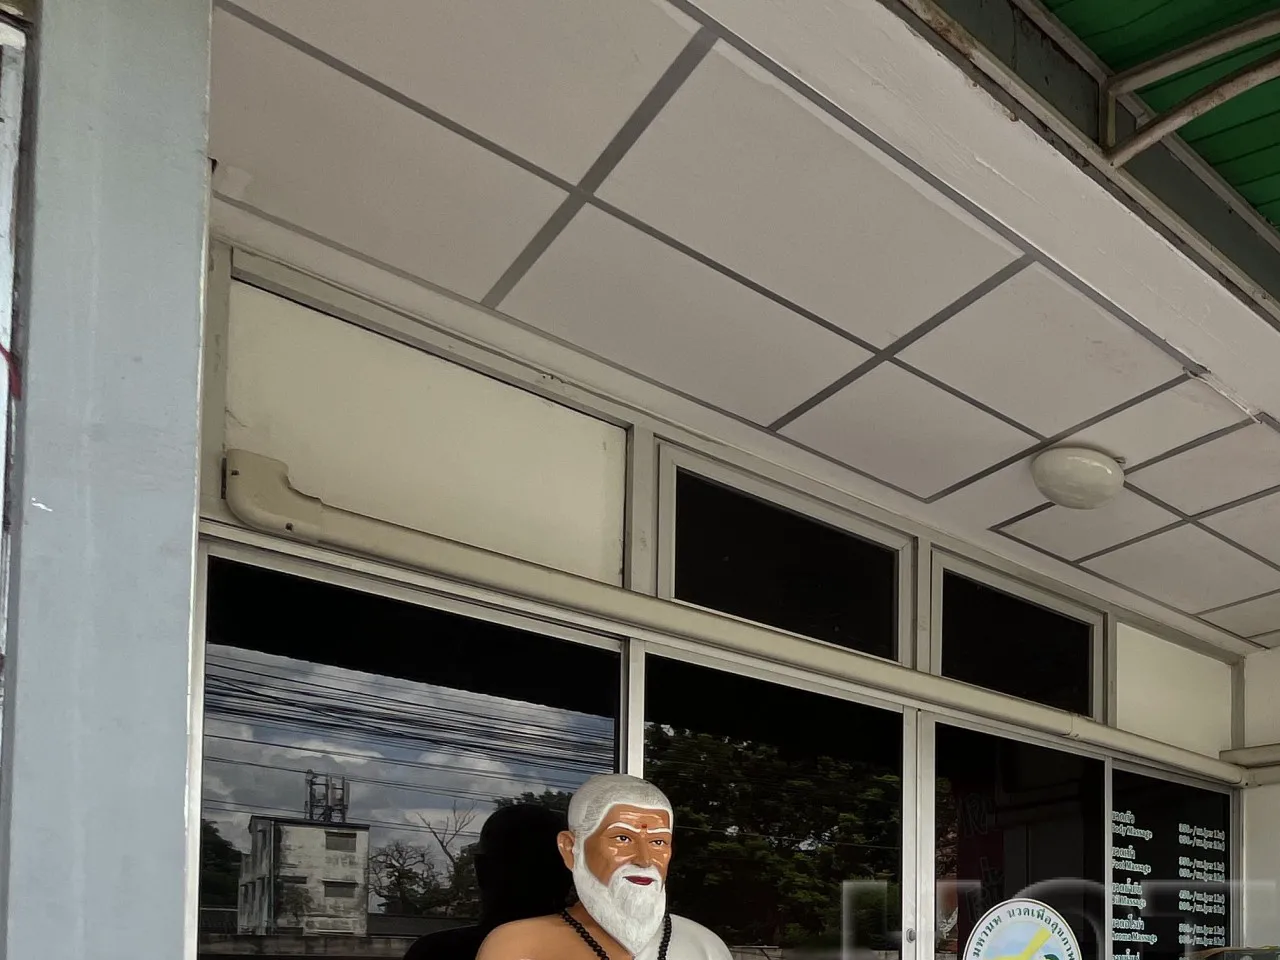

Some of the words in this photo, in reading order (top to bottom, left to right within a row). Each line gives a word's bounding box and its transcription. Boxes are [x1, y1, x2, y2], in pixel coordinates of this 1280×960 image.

[1127, 825, 1153, 840] Massage
[1125, 861, 1151, 875] Massage
[1121, 895, 1146, 909] Massage
[1131, 932, 1157, 945] Massage
